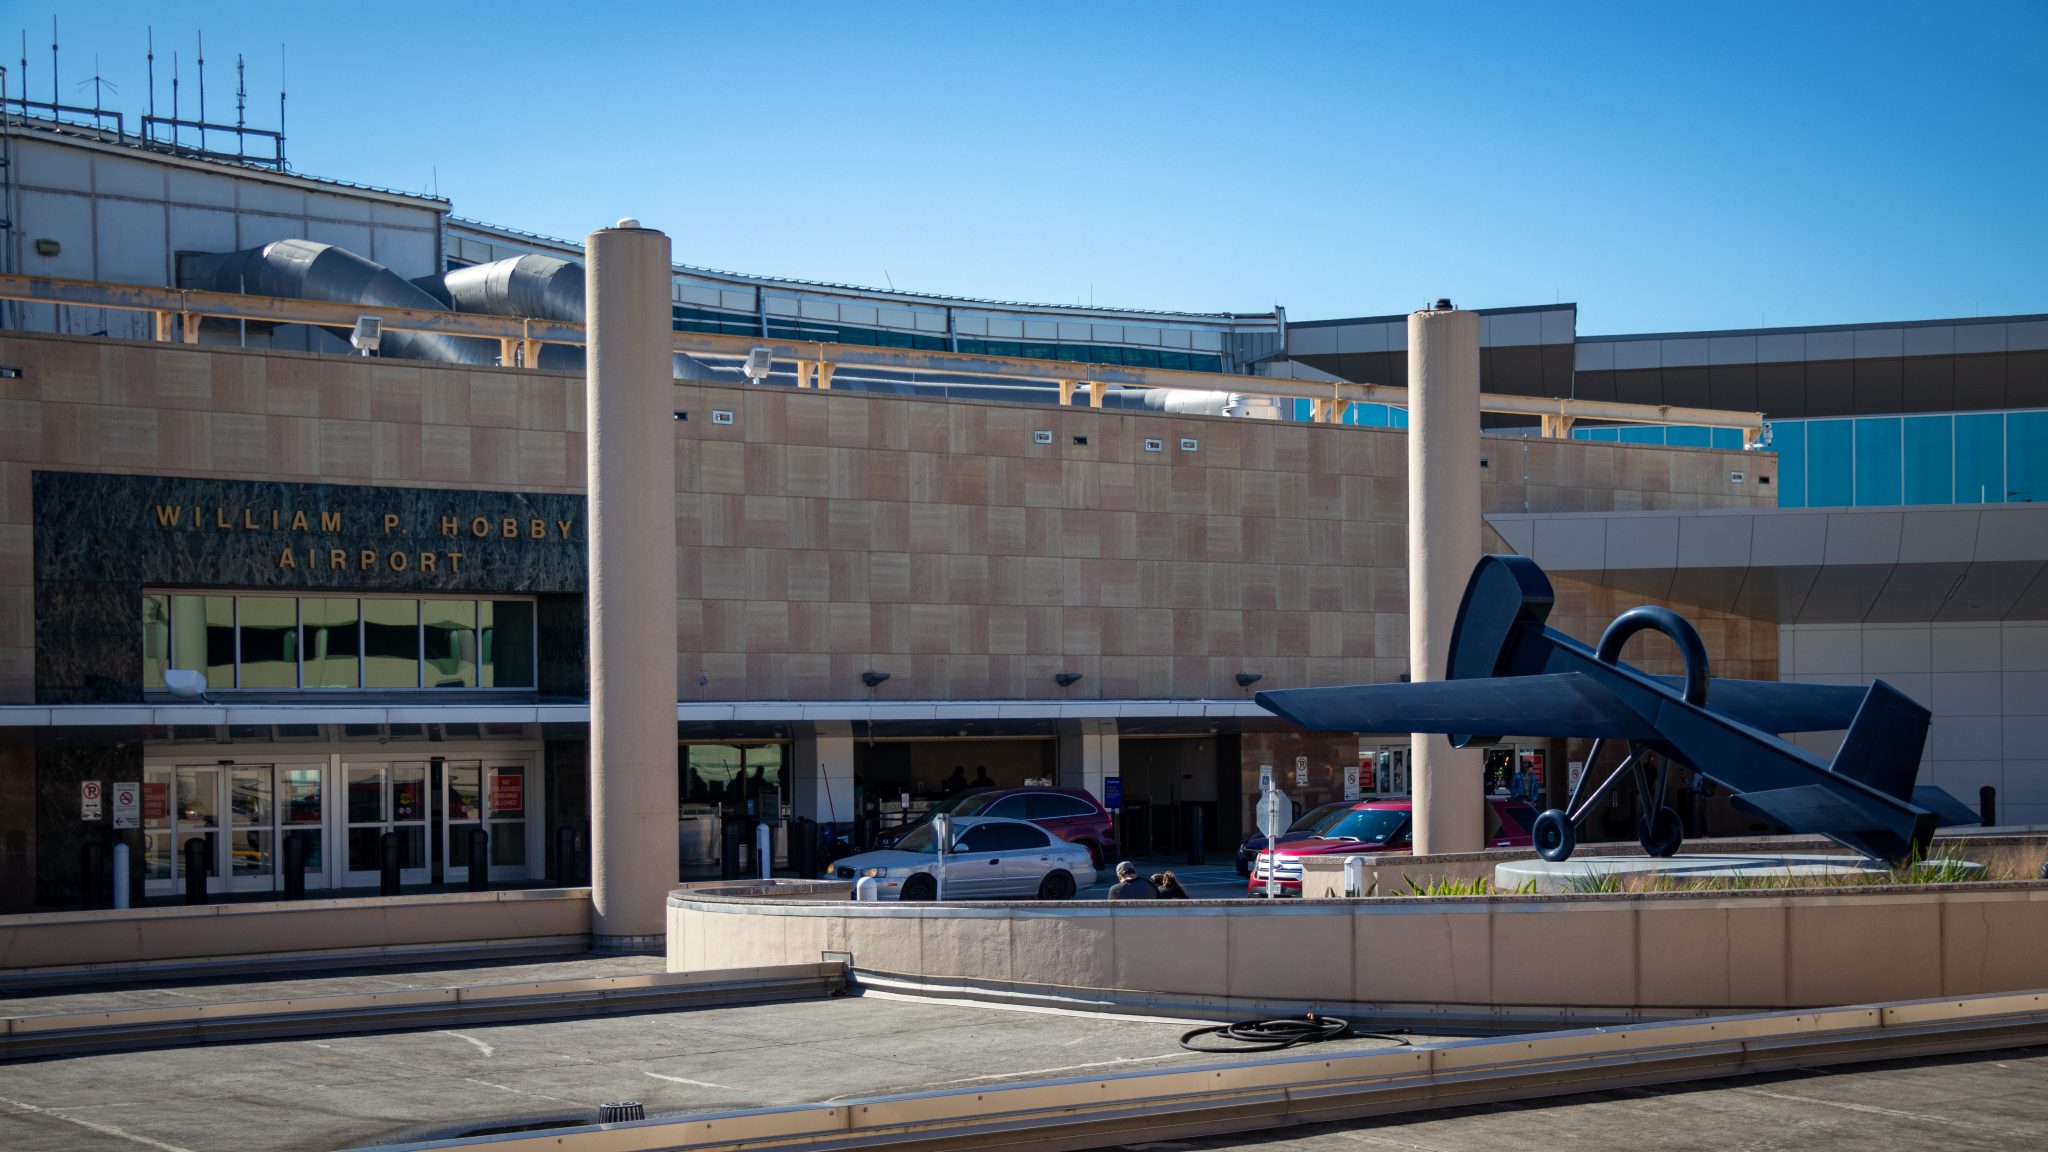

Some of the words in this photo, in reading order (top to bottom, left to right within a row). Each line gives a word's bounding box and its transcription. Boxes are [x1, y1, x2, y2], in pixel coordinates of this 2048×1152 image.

[156, 504, 341, 532] WILLIAM
[384, 513, 407, 534] P.
[441, 516, 572, 539] HOBBY
[279, 547, 463, 573] AIRPORT
